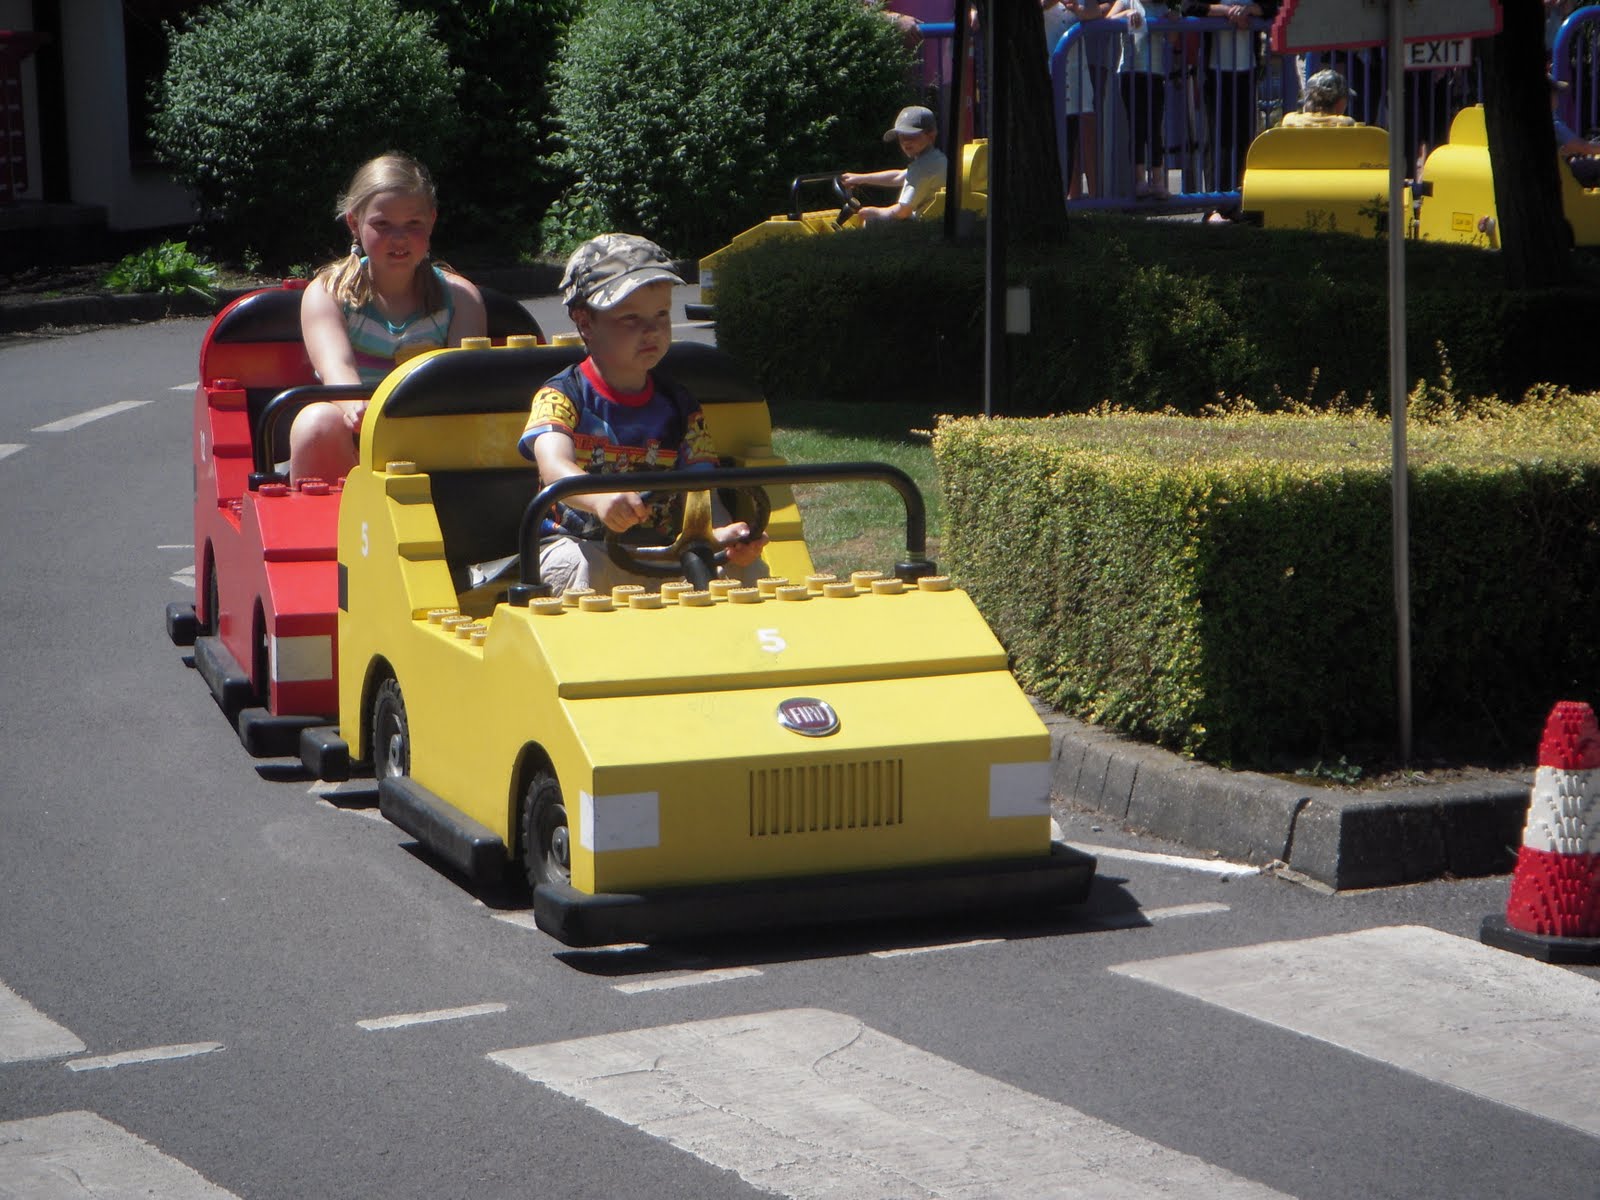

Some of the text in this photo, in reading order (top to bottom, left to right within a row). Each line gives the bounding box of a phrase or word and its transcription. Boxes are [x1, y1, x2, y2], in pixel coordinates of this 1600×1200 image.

[1411, 40, 1464, 63] EXIT
[361, 521, 369, 558] 5
[756, 627, 786, 654] 5
[788, 704, 826, 725] FIAT
